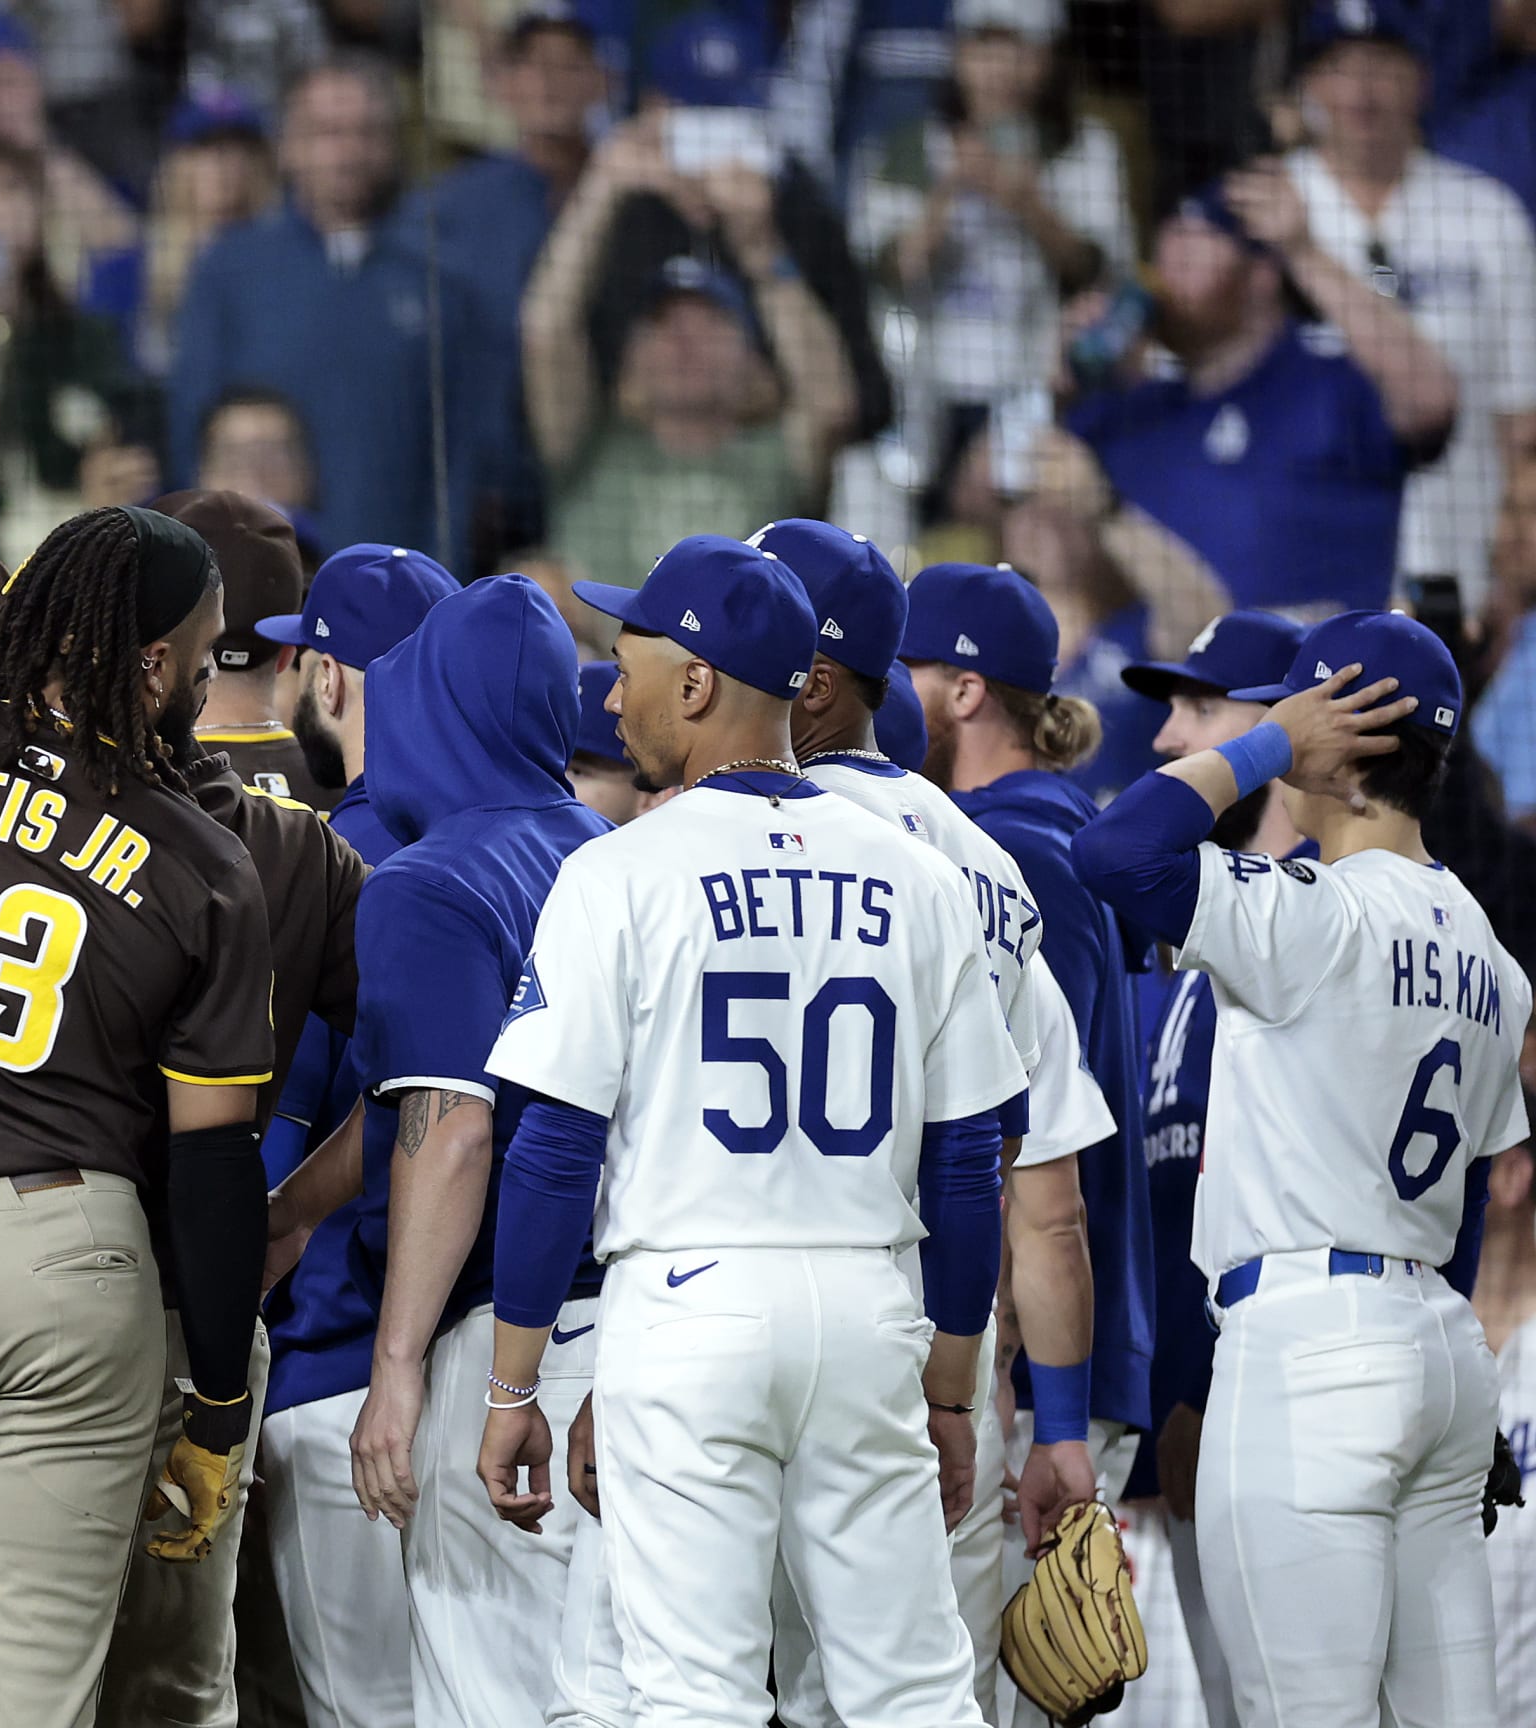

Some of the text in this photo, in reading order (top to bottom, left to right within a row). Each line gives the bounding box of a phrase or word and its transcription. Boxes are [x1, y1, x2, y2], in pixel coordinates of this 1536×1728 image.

[59, 813, 152, 909] JR.
[700, 869, 893, 947] BETTS
[961, 866, 1041, 970] DEZ
[1392, 939, 1501, 1036] H.S. KIM
[702, 971, 897, 1157] 50
[1388, 1037, 1462, 1202] 6
